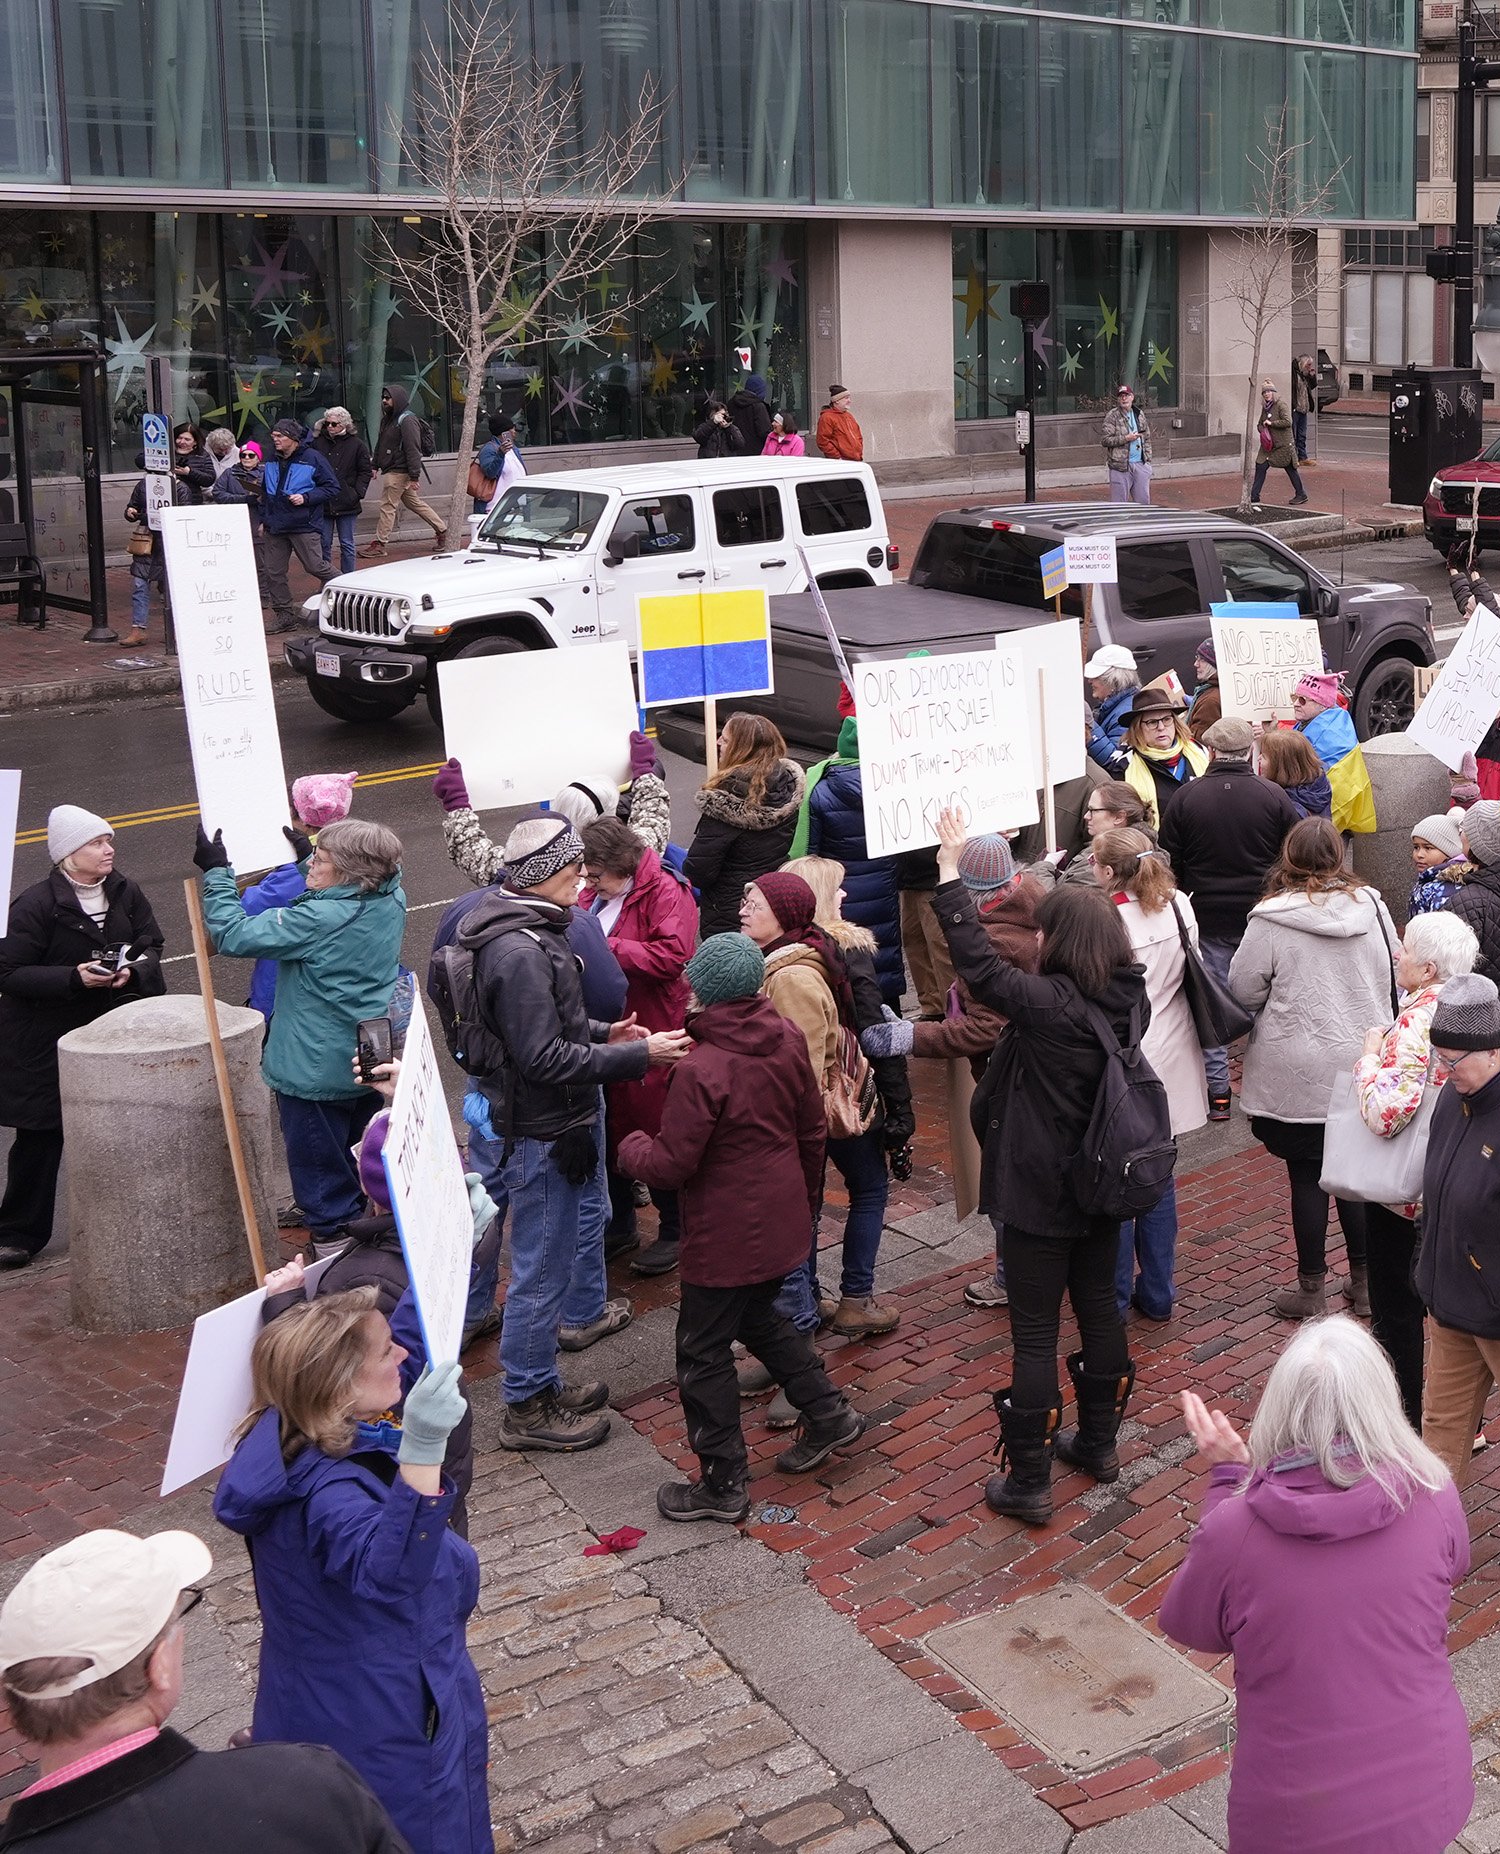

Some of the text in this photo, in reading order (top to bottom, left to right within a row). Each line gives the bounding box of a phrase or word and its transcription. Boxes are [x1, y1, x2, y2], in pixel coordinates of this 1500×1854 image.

[176, 519, 231, 550] Trump
[202, 553, 217, 566] and
[195, 582, 237, 602] Vance
[208, 615, 233, 624] were
[571, 623, 596, 636] Jeep
[1220, 628, 1254, 664] NO
[197, 669, 254, 702] RUDE
[863, 657, 1015, 708] OUR DEMOCRACY IS
[1443, 673, 1470, 697] WITH
[890, 690, 998, 745] NOT FOR SALE!
[1426, 688, 1486, 744] UKRAINE
[871, 758, 907, 791] DUMP
[987, 743, 1014, 767] MUSK
[878, 798, 911, 849] NO
[398, 1072, 427, 1198] IMPEACH
[1047, 1650, 1102, 1690] ELECTRIC
